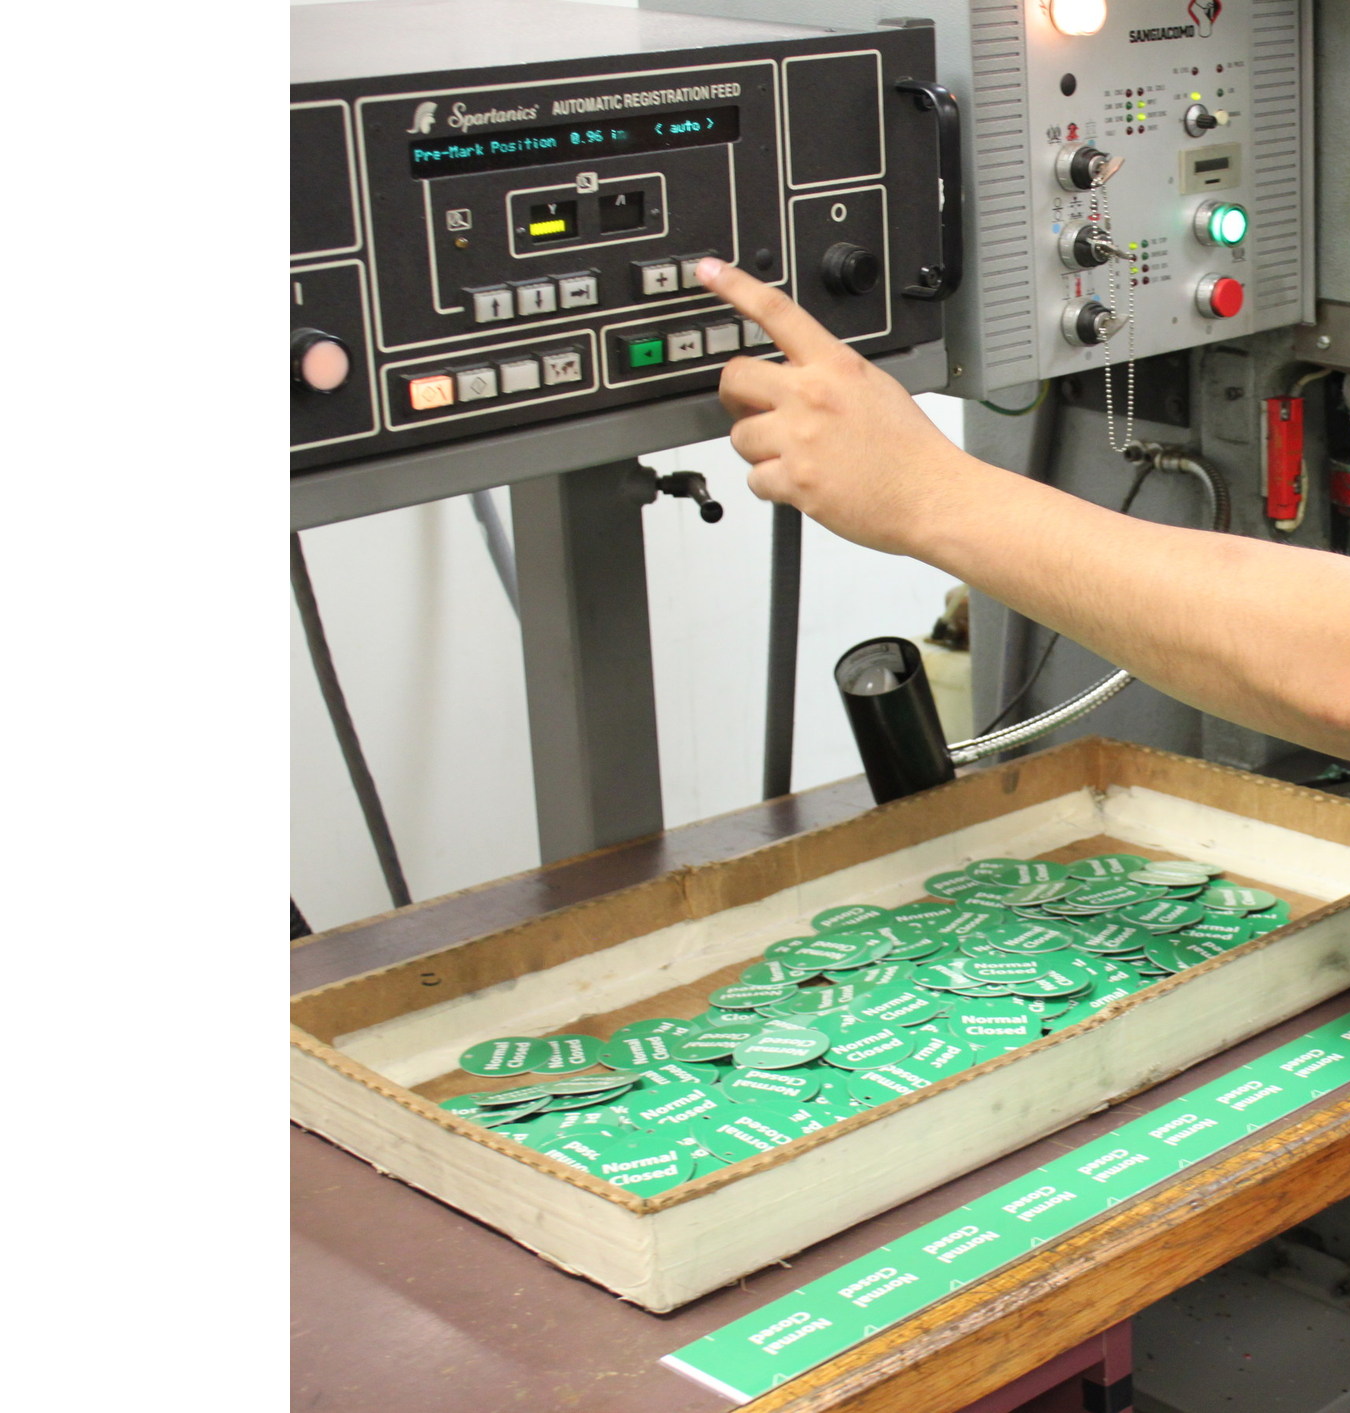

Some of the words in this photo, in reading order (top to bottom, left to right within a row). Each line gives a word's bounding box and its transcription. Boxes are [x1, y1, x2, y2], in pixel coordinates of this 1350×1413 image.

[1128, 25, 1195, 44] SANGIACOMO
[552, 94, 622, 116] AUTOMATIC
[623, 86, 709, 109] REGISTRATION
[711, 82, 741, 100] FEED
[448, 101, 537, 133] Spartanics
[413, 144, 484, 163] Pre-Mark
[490, 135, 557, 154] Position
[669, 120, 701, 135] auto
[895, 908, 952, 922] Normal
[1196, 924, 1240, 933] ormal
[973, 961, 1038, 970] Normal
[978, 968, 1037, 976] Closed
[862, 992, 916, 1016] Normal
[880, 999, 929, 1021] Closed
[1090, 988, 1129, 1008] ormal
[961, 1015, 1028, 1025] Normal
[965, 1026, 1028, 1035] Closed
[831, 1028, 894, 1055] Normal
[846, 1038, 905, 1062] Closed
[913, 1038, 946, 1061] rmal
[1280, 1048, 1325, 1071] Closed
[1293, 1052, 1345, 1078] Normal
[732, 1079, 801, 1096] Normal
[745, 1071, 807, 1086] Closed
[639, 1089, 706, 1120] Normal
[1215, 1080, 1264, 1105] Closed
[1229, 1084, 1284, 1112] Normal
[734, 1116, 793, 1145] Closed
[1147, 1113, 1199, 1140] Closed
[1162, 1118, 1219, 1147] Normal
[544, 1149, 591, 1173] ormal
[602, 1151, 678, 1174] Normal
[1076, 1148, 1130, 1176] Closed
[1091, 1152, 1149, 1184] Normal
[609, 1165, 678, 1186] Closed
[1000, 1185, 1056, 1216] Closed
[1017, 1190, 1078, 1222] Normal
[921, 1225, 979, 1256] Closed
[936, 1230, 1001, 1264] Normal
[836, 1266, 898, 1300] Closed
[851, 1272, 920, 1308] Normal
[746, 1311, 812, 1346] Closed
[761, 1318, 834, 1355] Normal
